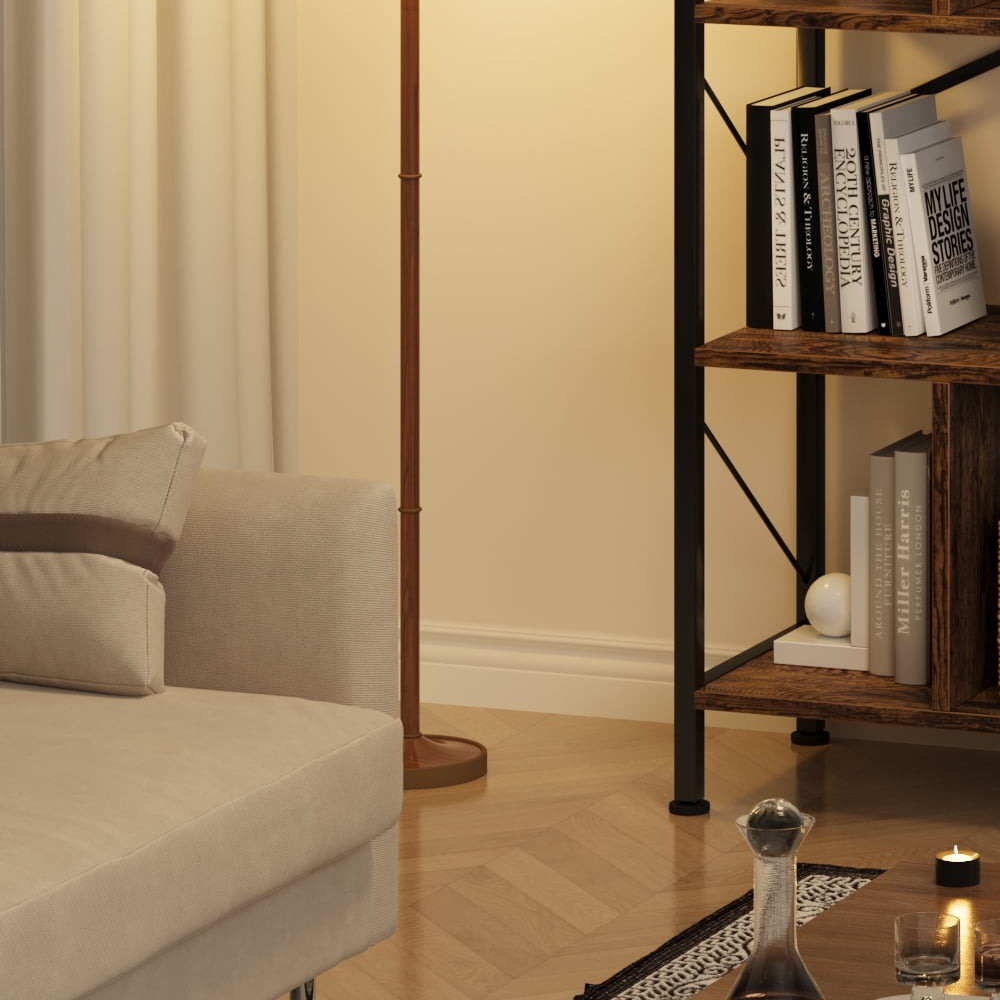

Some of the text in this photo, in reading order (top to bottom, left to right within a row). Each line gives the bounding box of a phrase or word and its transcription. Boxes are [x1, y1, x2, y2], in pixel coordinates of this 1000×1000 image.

[803, 192, 812, 205] &
[834, 148, 851, 288] ENCYCLOPEDIA
[864, 177, 875, 210] approach
[870, 218, 881, 258] MARKETING
[906, 167, 916, 193] MY LIFE
[924, 178, 968, 217] MY LIFE
[820, 172, 836, 295] ARCHEOLOGY
[848, 204, 863, 287] CENTURY
[880, 198, 898, 288] Graphic Design
[928, 203, 970, 241] DESIGN
[931, 227, 974, 265] STORIES
[875, 488, 883, 640] AROUND THE HOUSE
[897, 488, 910, 636] Miller Harris
[914, 504, 922, 621] PERFUMER LONDON
